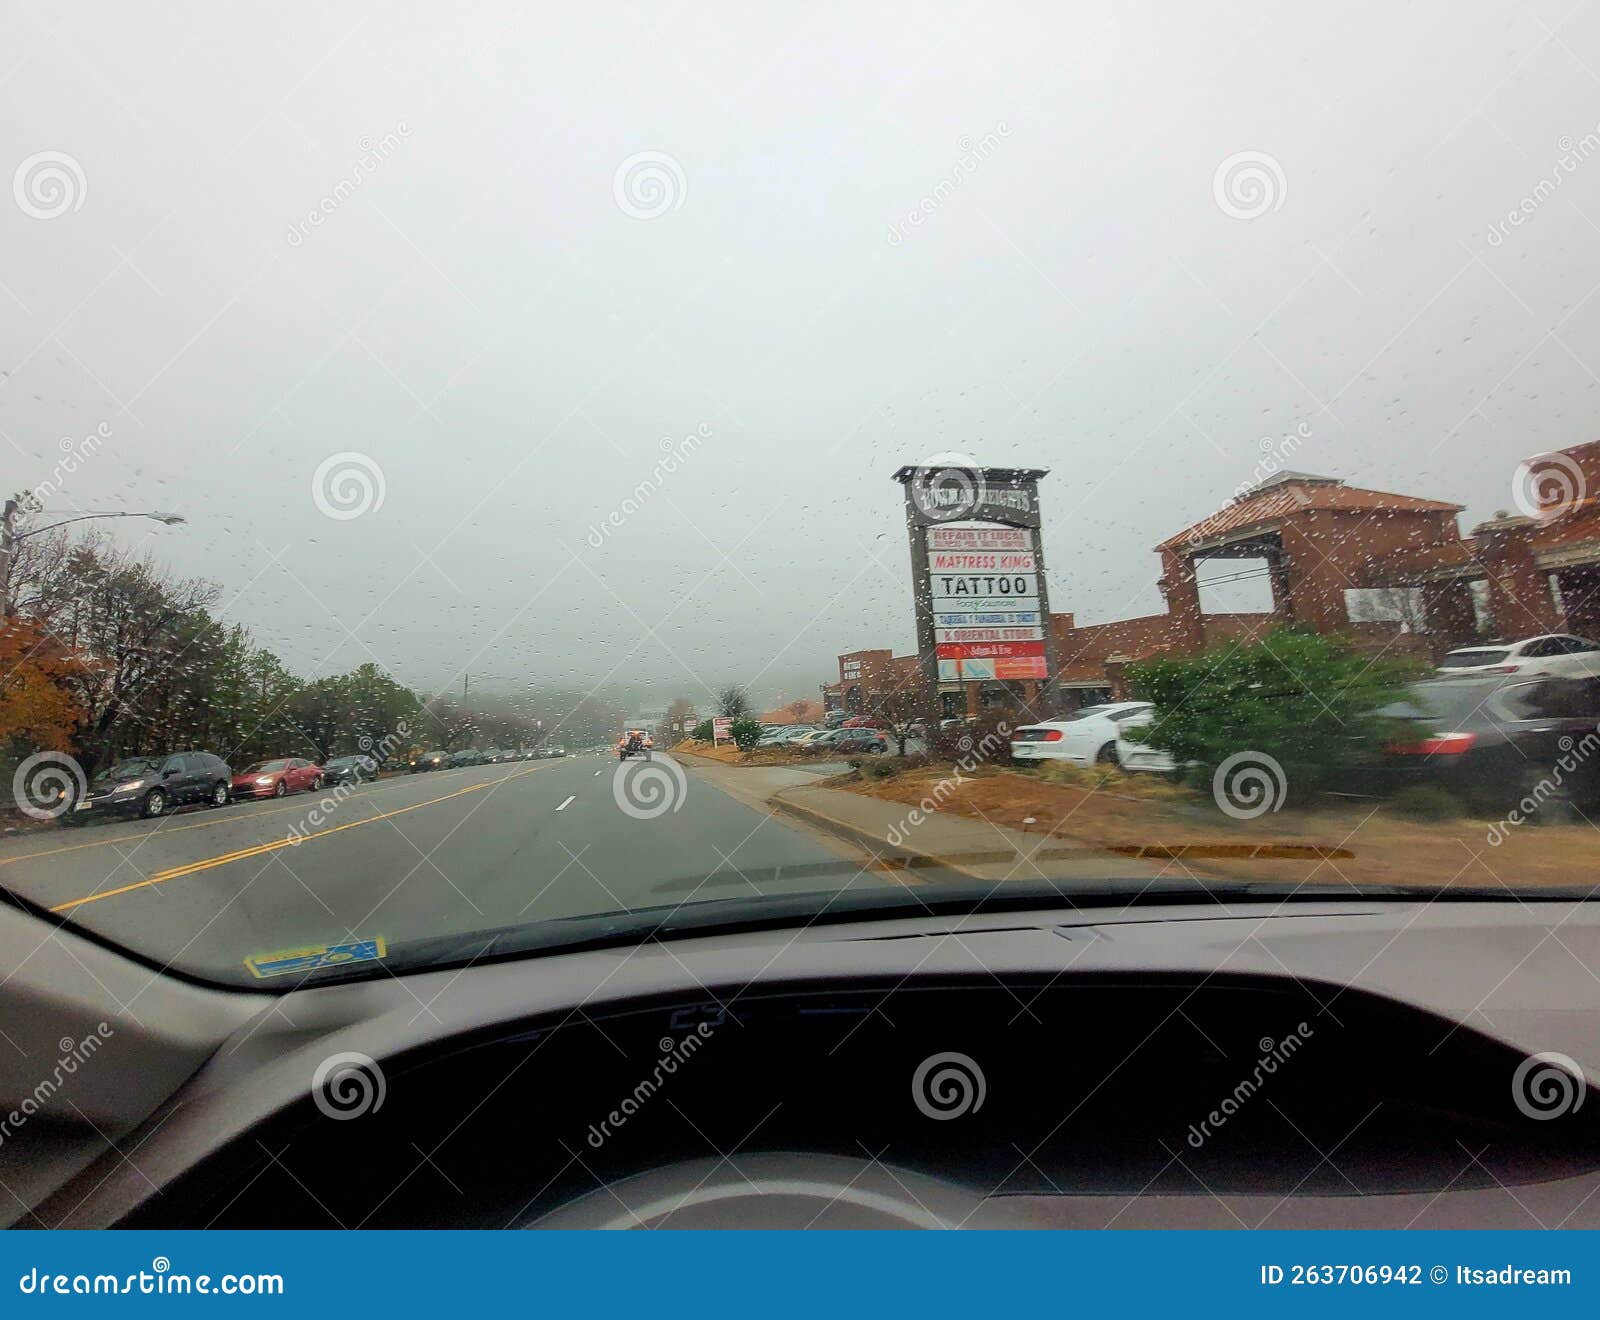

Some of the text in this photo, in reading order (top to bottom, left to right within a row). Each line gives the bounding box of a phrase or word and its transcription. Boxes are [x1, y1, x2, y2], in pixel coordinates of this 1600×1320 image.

[935, 555, 1031, 569] MATTRESS KING
[941, 577, 1026, 594] TATTOO
[1003, 629, 1035, 640] STORE
